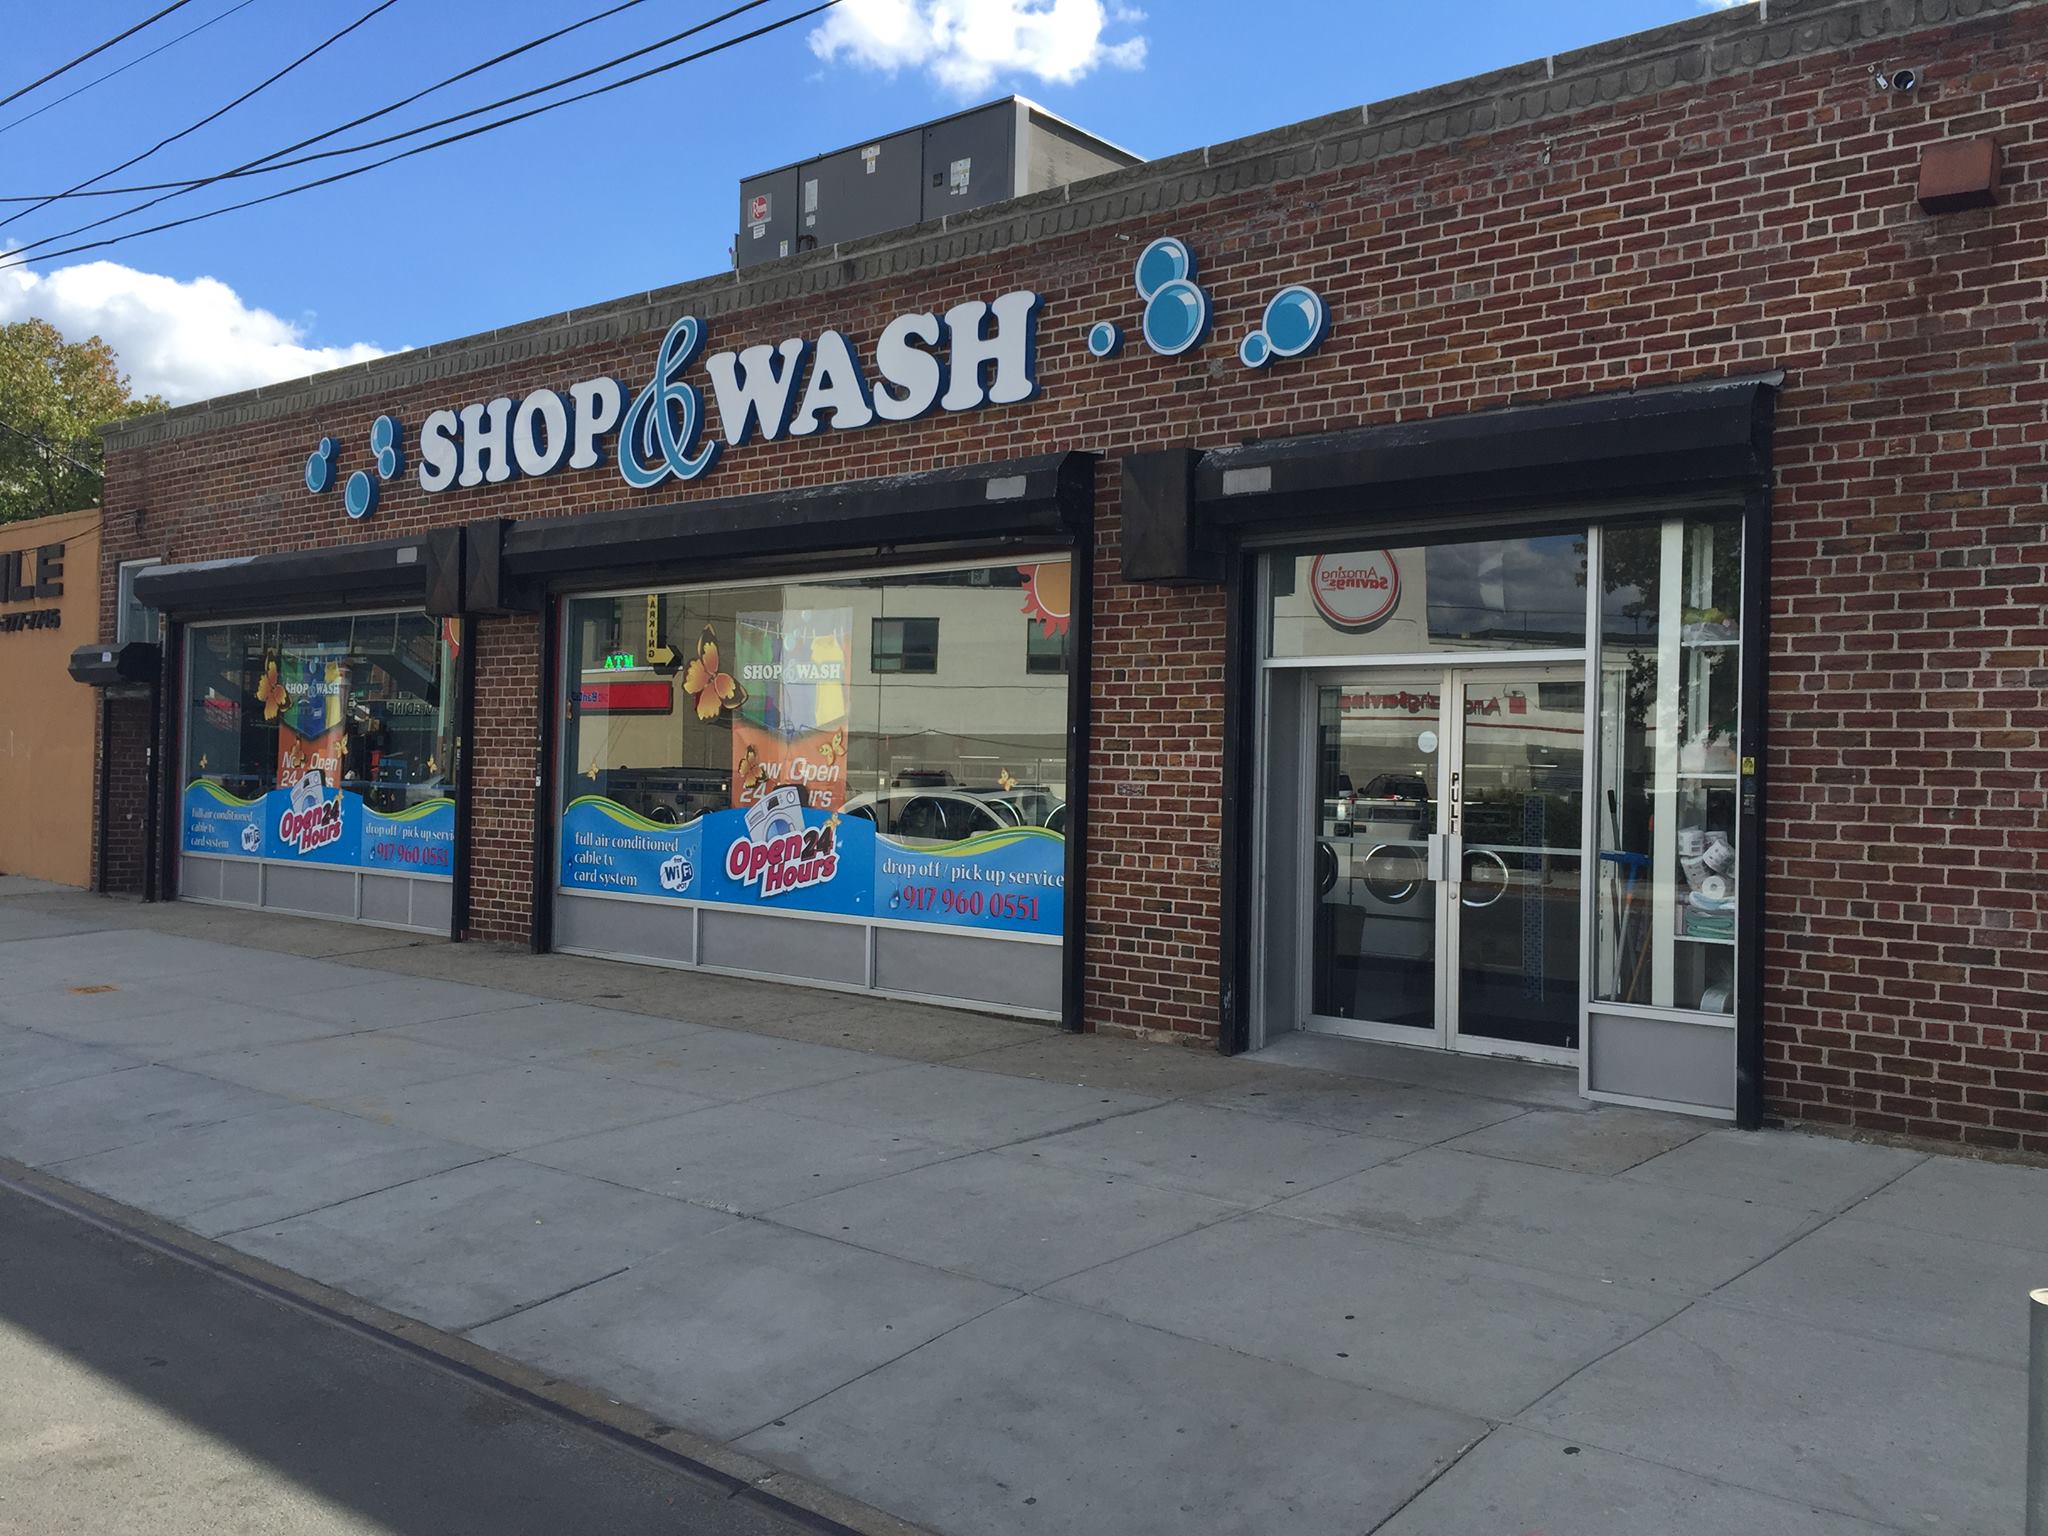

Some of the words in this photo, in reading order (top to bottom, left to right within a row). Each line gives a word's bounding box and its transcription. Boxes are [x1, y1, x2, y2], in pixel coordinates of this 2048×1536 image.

[419, 376, 629, 492] SHOP
[618, 315, 724, 488] &
[706, 290, 1044, 446] WASH
[604, 654, 635, 669] ATM
[743, 664, 782, 680] SHOP
[796, 663, 841, 680] WASH
[285, 682, 308, 695] SHOP
[316, 682, 340, 695] WASH
[310, 752, 338, 771] Open
[790, 757, 839, 785] Open
[281, 806, 323, 842] Open
[322, 801, 340, 826] 24
[365, 823, 384, 836] drop
[402, 826, 419, 840] pick
[420, 830, 431, 841] up
[432, 829, 455, 841] servi
[301, 821, 341, 850] Hours
[575, 831, 593, 846] full
[595, 834, 610, 847] air
[611, 835, 679, 852] conditioned
[377, 841, 396, 860] 917
[397, 843, 420, 863] 960
[423, 847, 449, 867] 0551
[574, 850, 602, 865] cable
[604, 853, 615, 866] tv
[730, 834, 803, 880] Open
[801, 826, 834, 861] 24
[574, 869, 597, 882] card
[600, 872, 638, 887] system
[765, 855, 837, 892] Hours
[882, 858, 916, 878] drop
[919, 860, 942, 877] off
[951, 863, 983, 883] pick
[985, 869, 1006, 886] up
[1008, 870, 1064, 888] service
[903, 885, 938, 911] 917
[941, 889, 984, 915] 960
[989, 892, 1039, 921] 0551
